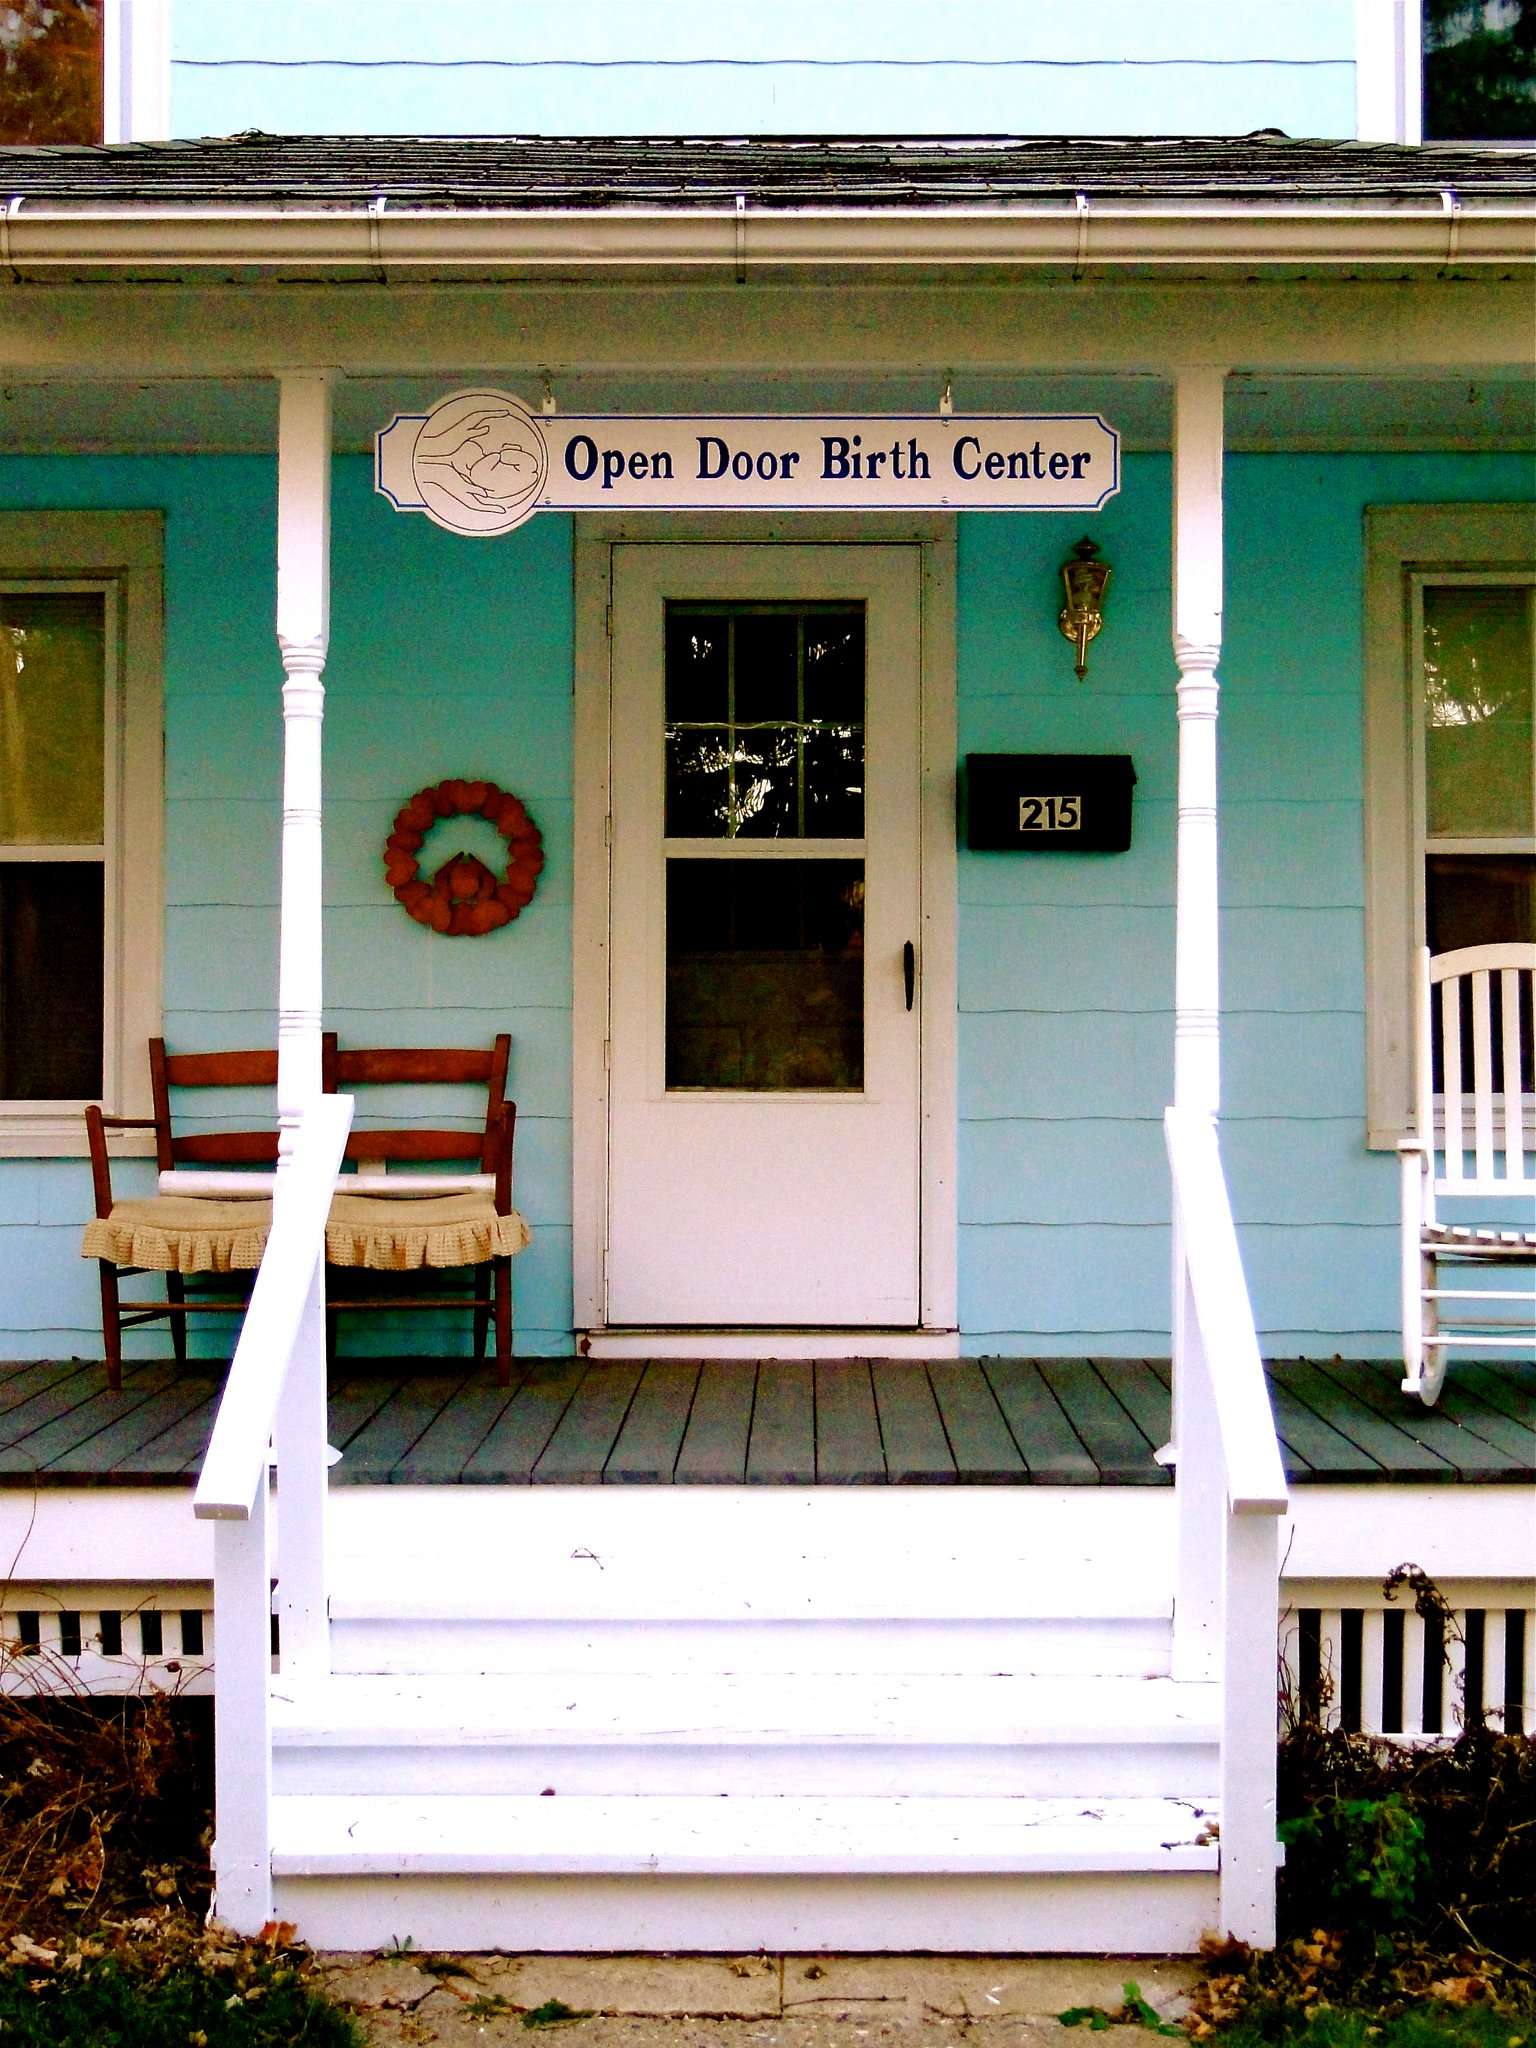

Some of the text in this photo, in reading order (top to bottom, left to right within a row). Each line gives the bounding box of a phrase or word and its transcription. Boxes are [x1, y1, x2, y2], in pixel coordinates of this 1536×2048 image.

[564, 434, 1092, 489] Open Door Birth Center
[1021, 797, 1078, 830] 215
